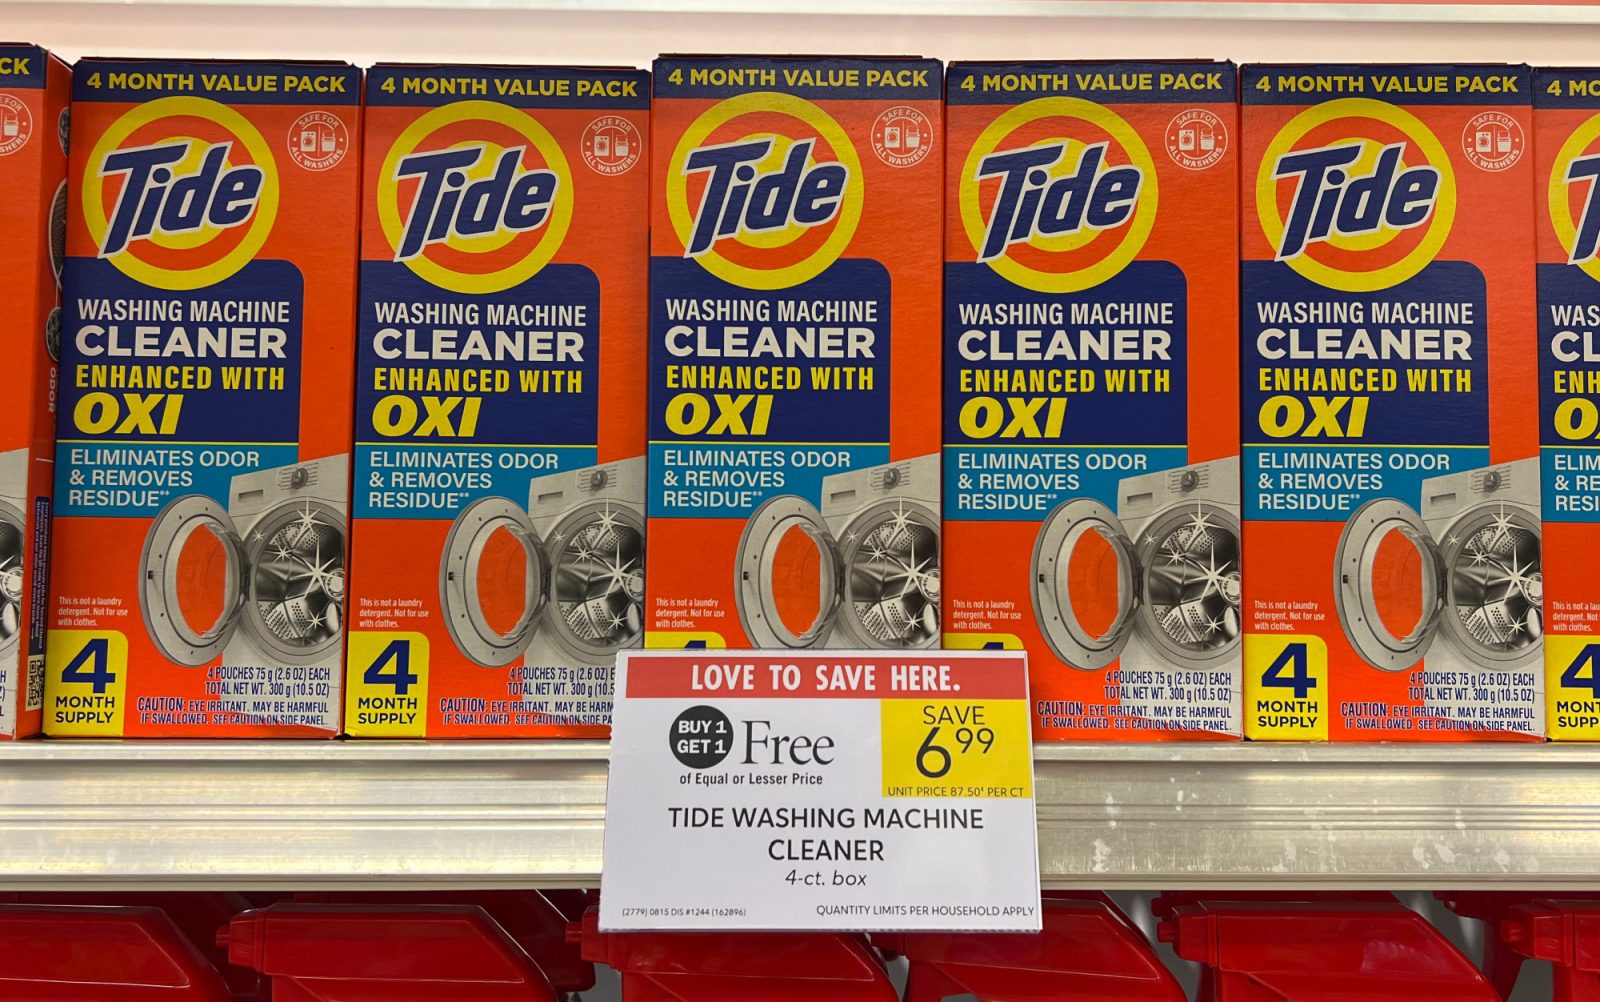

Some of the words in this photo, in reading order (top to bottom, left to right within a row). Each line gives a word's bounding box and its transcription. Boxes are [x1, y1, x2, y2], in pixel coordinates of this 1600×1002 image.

[87, 73, 102, 88] 4
[109, 73, 194, 90] MONTH
[201, 74, 277, 91] VALUE
[284, 76, 345, 92] PACK
[381, 77, 396, 93] 4
[403, 78, 487, 94] MONTH
[494, 79, 570, 96] VALUE
[577, 80, 637, 97] PACK
[668, 69, 683, 85] 4
[691, 69, 775, 86] MONTH
[783, 69, 859, 86] VALUE
[866, 70, 928, 87] PACK
[961, 75, 975, 91] 4
[983, 74, 1068, 92] MONTH
[1075, 73, 1152, 91] VALUE
[1160, 73, 1223, 90] PACK
[1256, 76, 1271, 92] 4
[1278, 76, 1363, 92] MONTH
[1371, 76, 1448, 92] VALUE
[1456, 76, 1518, 92] PACK
[1546, 80, 1562, 96] 4
[1473, 114, 1494, 127] SAFE
[1497, 115, 1514, 128] FOR
[1466, 147, 1479, 163] ALL
[1480, 149, 1520, 169] WASHERS
[97, 141, 264, 259] Tide
[392, 145, 560, 263] Tide
[681, 137, 850, 259] Tide
[974, 140, 1144, 263] Tide
[1271, 142, 1441, 262] Tide
[78, 299, 182, 321] WASHING
[190, 301, 289, 322] MACHINE
[375, 302, 479, 325] WASHING
[487, 304, 586, 326] MACHINE
[666, 299, 769, 321] WASHING
[778, 300, 877, 322] MACHINE
[959, 303, 1063, 325] WASHING
[1071, 303, 1173, 324] MACHINE
[1257, 302, 1363, 323] WASHING
[1372, 302, 1473, 324] MACHINE
[76, 325, 286, 358] CLEANER
[373, 328, 584, 362] CLEANER
[665, 325, 875, 358] CLEANER
[958, 330, 1171, 361] CLEANER
[1257, 328, 1472, 360] CLEANER
[76, 365, 211, 389] ENHANCED
[222, 367, 284, 390] WITH
[374, 368, 509, 392] ENHANCED
[519, 370, 582, 393] WITH
[667, 365, 801, 389] ENHANCED
[811, 367, 873, 390] WITH
[960, 369, 1095, 392] ENHANCED
[1105, 369, 1169, 392] WITH
[1260, 368, 1397, 391] ENHANCED
[1407, 369, 1471, 392] WITH
[74, 392, 184, 434] OXI
[372, 395, 482, 437] OXI
[665, 393, 773, 435] OXI
[959, 397, 1067, 438] OXI
[1259, 395, 1369, 437] OXI
[71, 449, 194, 466] ELIMINATES
[200, 450, 259, 467] ODOR
[664, 450, 785, 467] ELIMINATES
[791, 451, 850, 467] ODOR
[1259, 453, 1383, 469] ELIMINATES
[1389, 454, 1449, 470] ODOR
[69, 469, 85, 485] &
[92, 469, 192, 487] REMOVES
[664, 470, 678, 486] &
[685, 470, 785, 487] REMOVES
[1258, 473, 1273, 489] &
[1281, 473, 1383, 490] REMOVES
[1255, 600, 1267, 610] This
[1268, 601, 1274, 610] is
[1275, 601, 1286, 610] not
[1293, 601, 1318, 612] laundry
[1254, 612, 1288, 622] detergent.
[1289, 612, 1301, 621] Not
[1303, 612, 1312, 621] for
[1255, 622, 1269, 631] with
[61, 639, 116, 693] 4
[1261, 643, 1317, 698] 4
[692, 665, 754, 690] LOVE
[769, 665, 800, 690] TO
[816, 666, 876, 691] SAVE
[891, 666, 960, 691] HERE.
[1410, 673, 1415, 684] 4
[1418, 673, 1456, 685] POUCHES
[1459, 673, 1469, 685] 75
[1471, 676, 1476, 688] g
[1478, 673, 1494, 688] (2.6
[1497, 673, 1510, 688] OZ)
[1513, 673, 1534, 686] EACH
[56, 696, 115, 708] MONTH
[1409, 687, 1434, 700] TOTAL
[1437, 687, 1452, 700] NET
[1455, 688, 1470, 700] WT.
[1473, 688, 1488, 701] 300
[1490, 691, 1496, 704] g
[1498, 689, 1518, 703] (10.5
[1521, 689, 1535, 704] OZ)
[55, 711, 114, 723] SUPPLY
[923, 705, 985, 725] SAVE
[1257, 700, 1318, 713] MONTH
[1341, 702, 1390, 716] CAUTION:
[1394, 706, 1408, 717] EYE
[1458, 707, 1477, 718] MAY
[1479, 707, 1490, 718] BE
[1493, 708, 1535, 719] HARMFUL
[679, 721, 711, 735] BUY
[716, 721, 727, 734] 1
[1258, 716, 1317, 728] SUPPLY
[1346, 718, 1353, 729] IF
[1418, 720, 1433, 730] SEE
[1435, 720, 1470, 731] CAUTION
[1473, 720, 1484, 731] ON
[1486, 721, 1504, 731] SIDE
[677, 740, 711, 754] GET
[715, 740, 726, 754] 1
[741, 720, 835, 765] Free
[680, 773, 691, 785] of
[695, 773, 728, 787] Equal
[732, 776, 744, 785] or
[749, 773, 787, 785] Lesser
[792, 773, 823, 785] Price
[888, 787, 914, 797] UNIT
[916, 787, 948, 797] PRICE
[987, 788, 1008, 797] PER
[1010, 788, 1024, 798] CT
[668, 807, 724, 828] TIDE
[732, 807, 856, 829] WASHING
[865, 808, 984, 829] MACHINE
[768, 839, 884, 861] CLEANER
[785, 870, 826, 886] 4-ct.
[832, 870, 867, 886] box
[622, 908, 647, 917] (2779)
[649, 908, 669, 916] 0815
[671, 908, 684, 916] DIS
[685, 908, 710, 916] #1244
[711, 907, 747, 917] (162896)
[816, 905, 872, 916] QUANTITY
[874, 905, 907, 915] LIMITS
[910, 905, 929, 915] PER
[931, 905, 999, 916] HOUSEHOLD
[1002, 905, 1035, 916] APPLY
